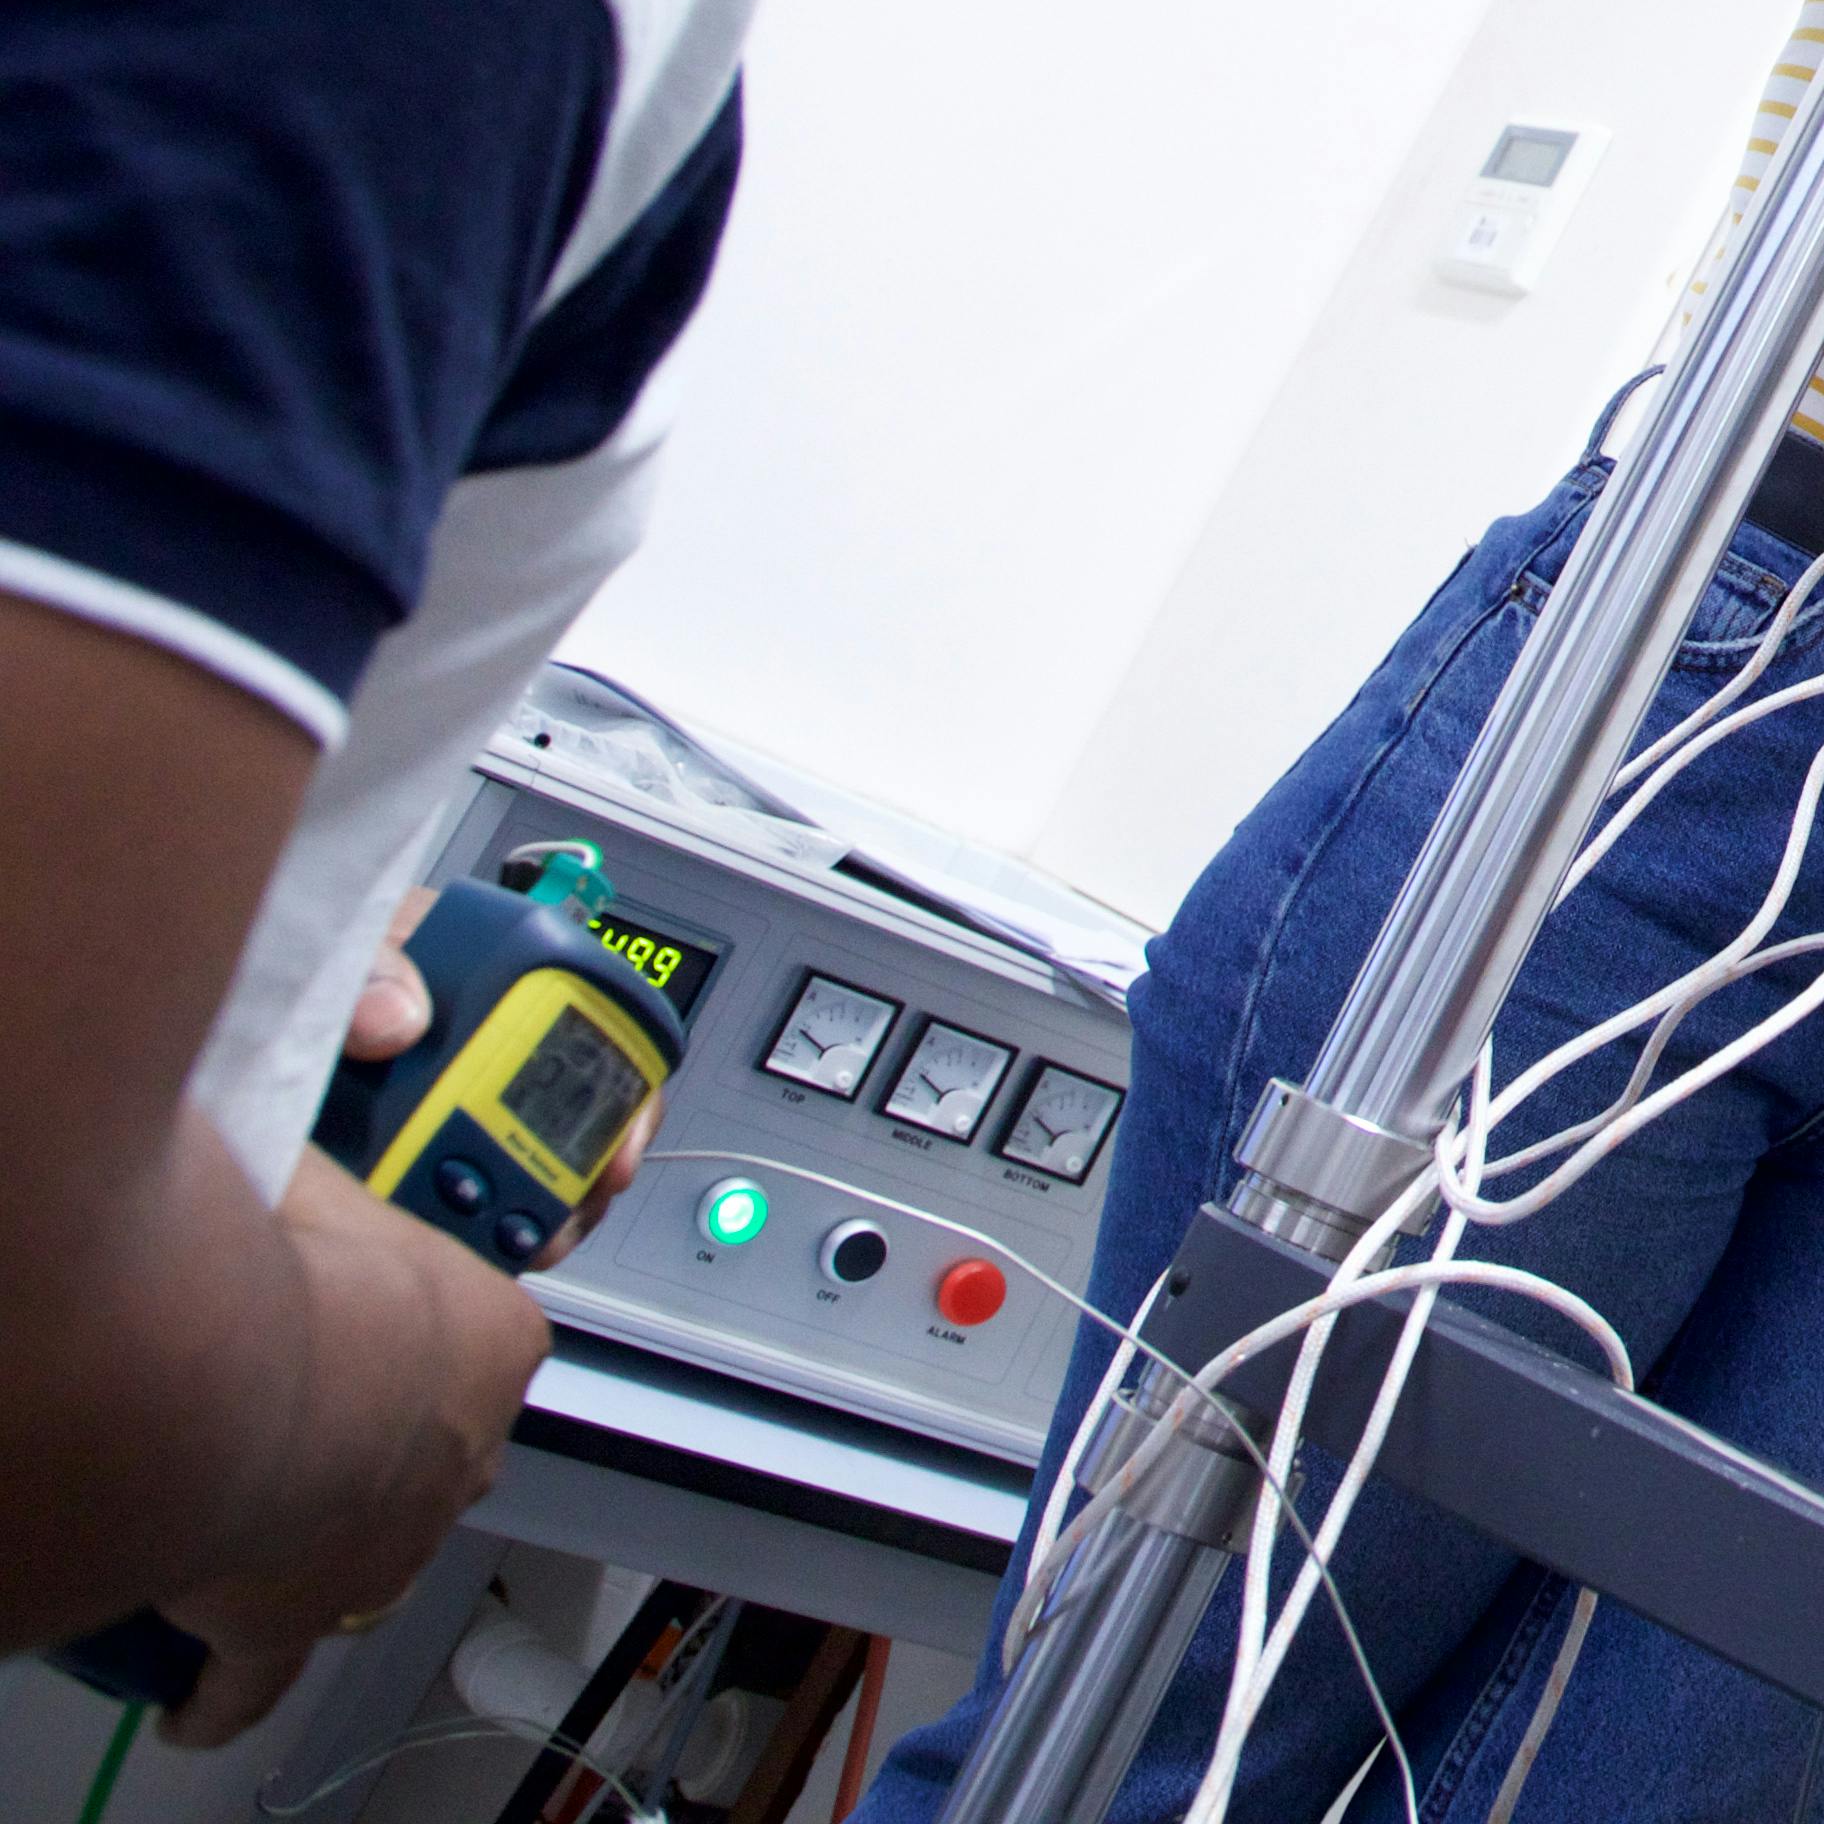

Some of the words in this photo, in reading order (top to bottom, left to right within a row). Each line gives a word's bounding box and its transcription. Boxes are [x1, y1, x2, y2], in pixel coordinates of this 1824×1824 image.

[782, 1087, 806, 1106] TOP
[892, 1128, 931, 1151] MIDDLE
[1002, 1168, 1050, 1193] BOTTOM
[696, 1249, 715, 1264] ON
[816, 1288, 841, 1305] OFF
[927, 1324, 967, 1345] ALARM
